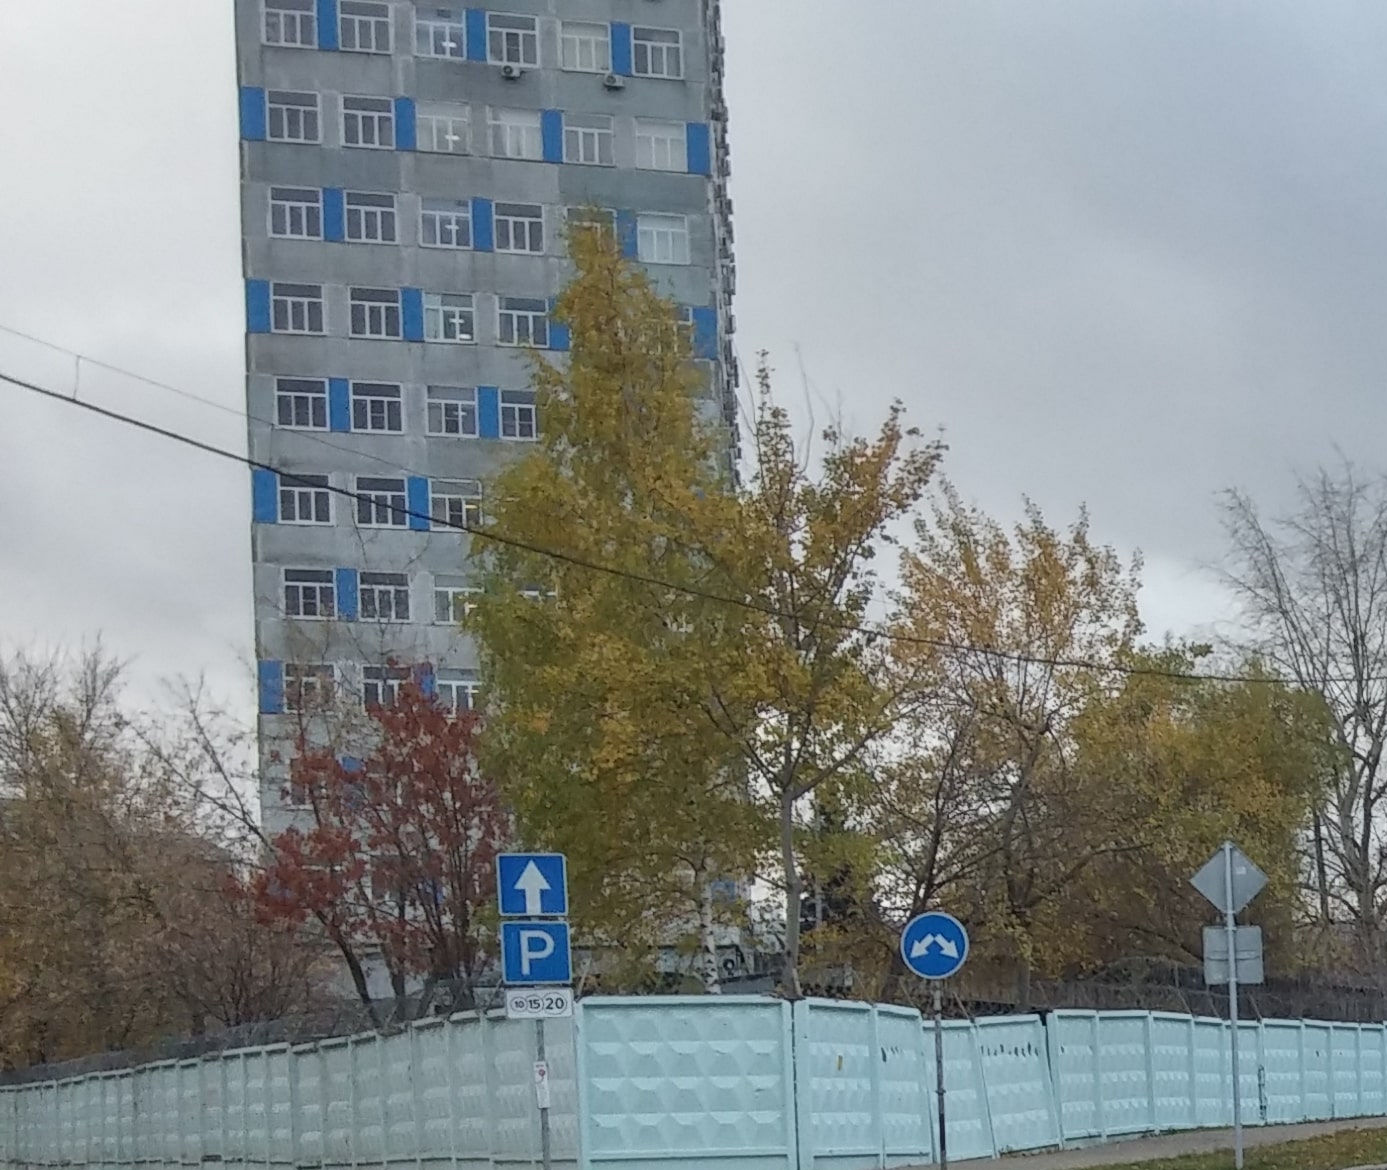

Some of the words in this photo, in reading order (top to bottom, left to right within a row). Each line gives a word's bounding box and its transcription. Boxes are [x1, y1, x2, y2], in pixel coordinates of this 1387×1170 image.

[519, 929, 555, 975] P
[514, 1000, 525, 1009] 10
[528, 999, 541, 1010] 15
[545, 997, 565, 1010] 20
